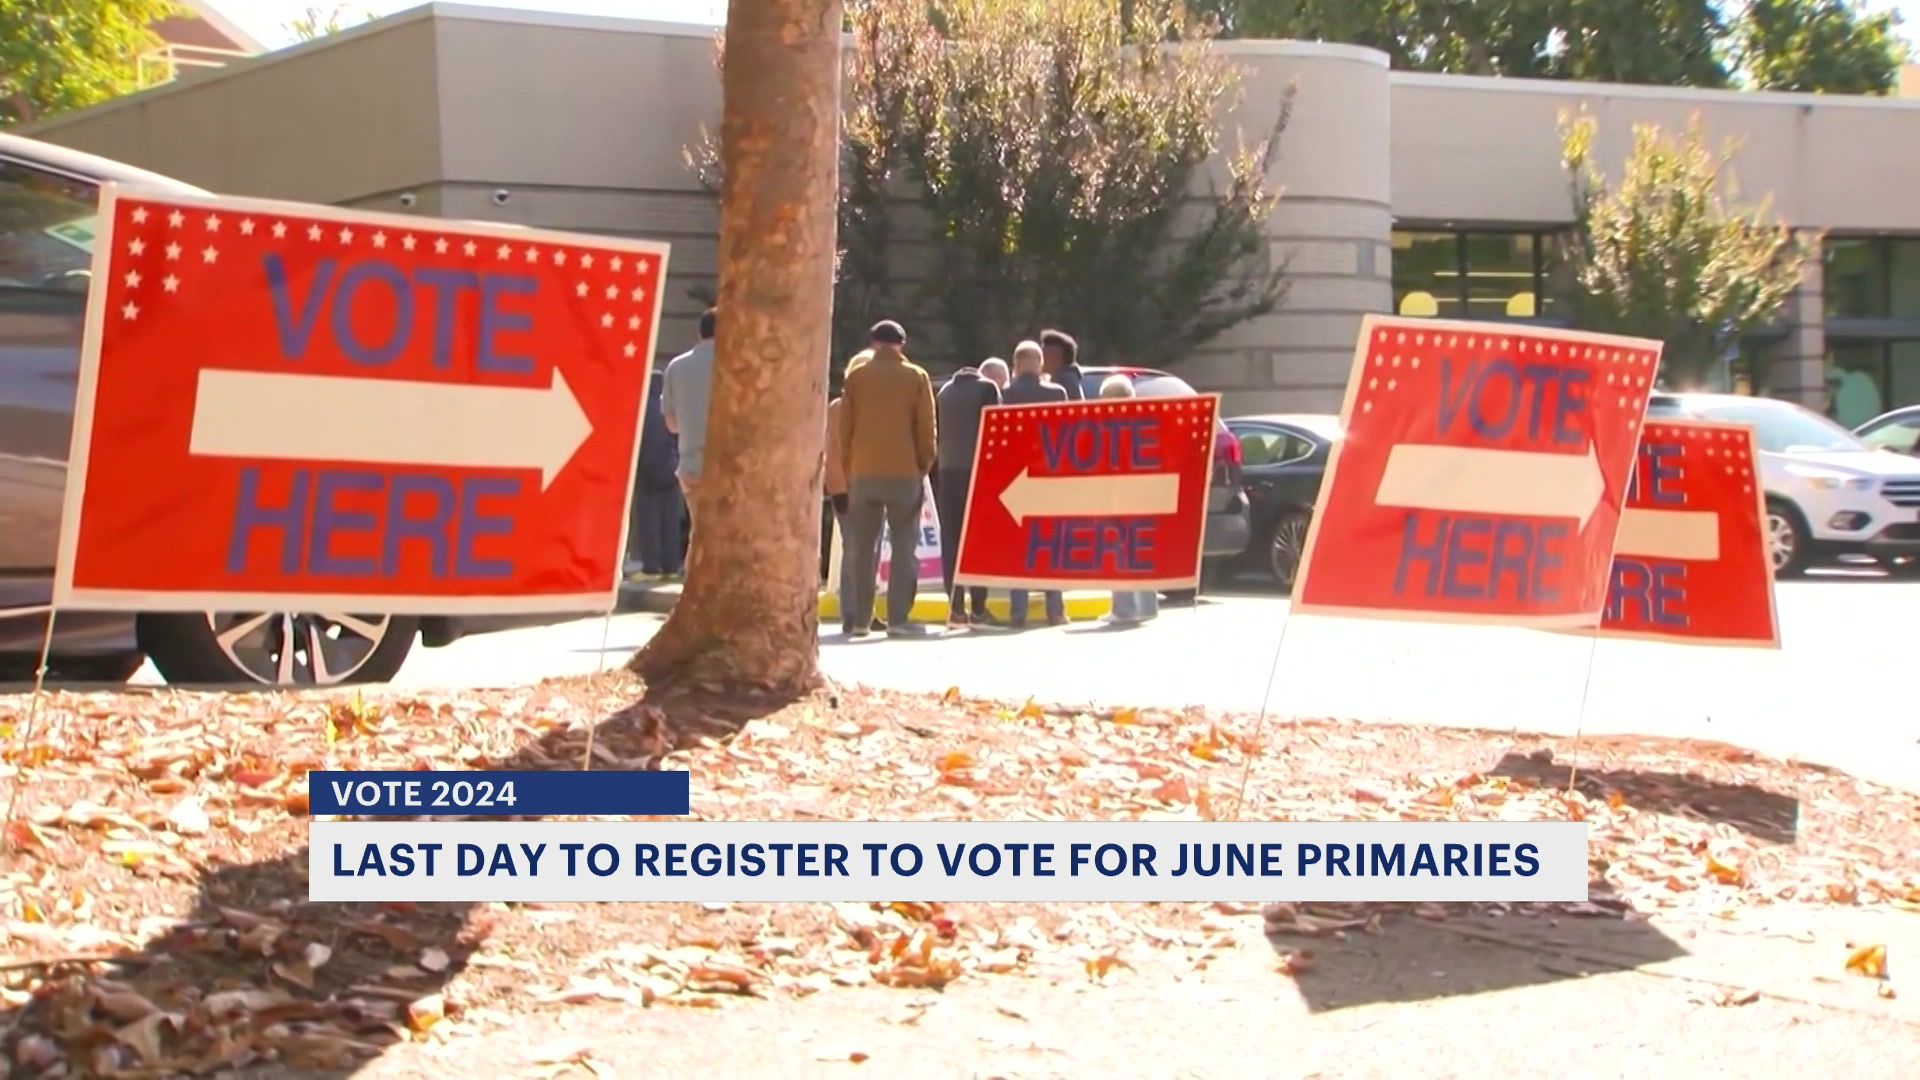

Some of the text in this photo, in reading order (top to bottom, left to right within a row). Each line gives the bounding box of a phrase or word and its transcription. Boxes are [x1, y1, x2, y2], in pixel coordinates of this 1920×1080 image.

[263, 252, 539, 375] VOTE
[1039, 417, 1161, 470] VOTE
[1436, 356, 1591, 445] VOTE
[225, 468, 521, 578] HERE
[1025, 517, 1157, 572] HERE
[1392, 513, 1571, 602] HERE
[1604, 558, 1689, 626] RE
